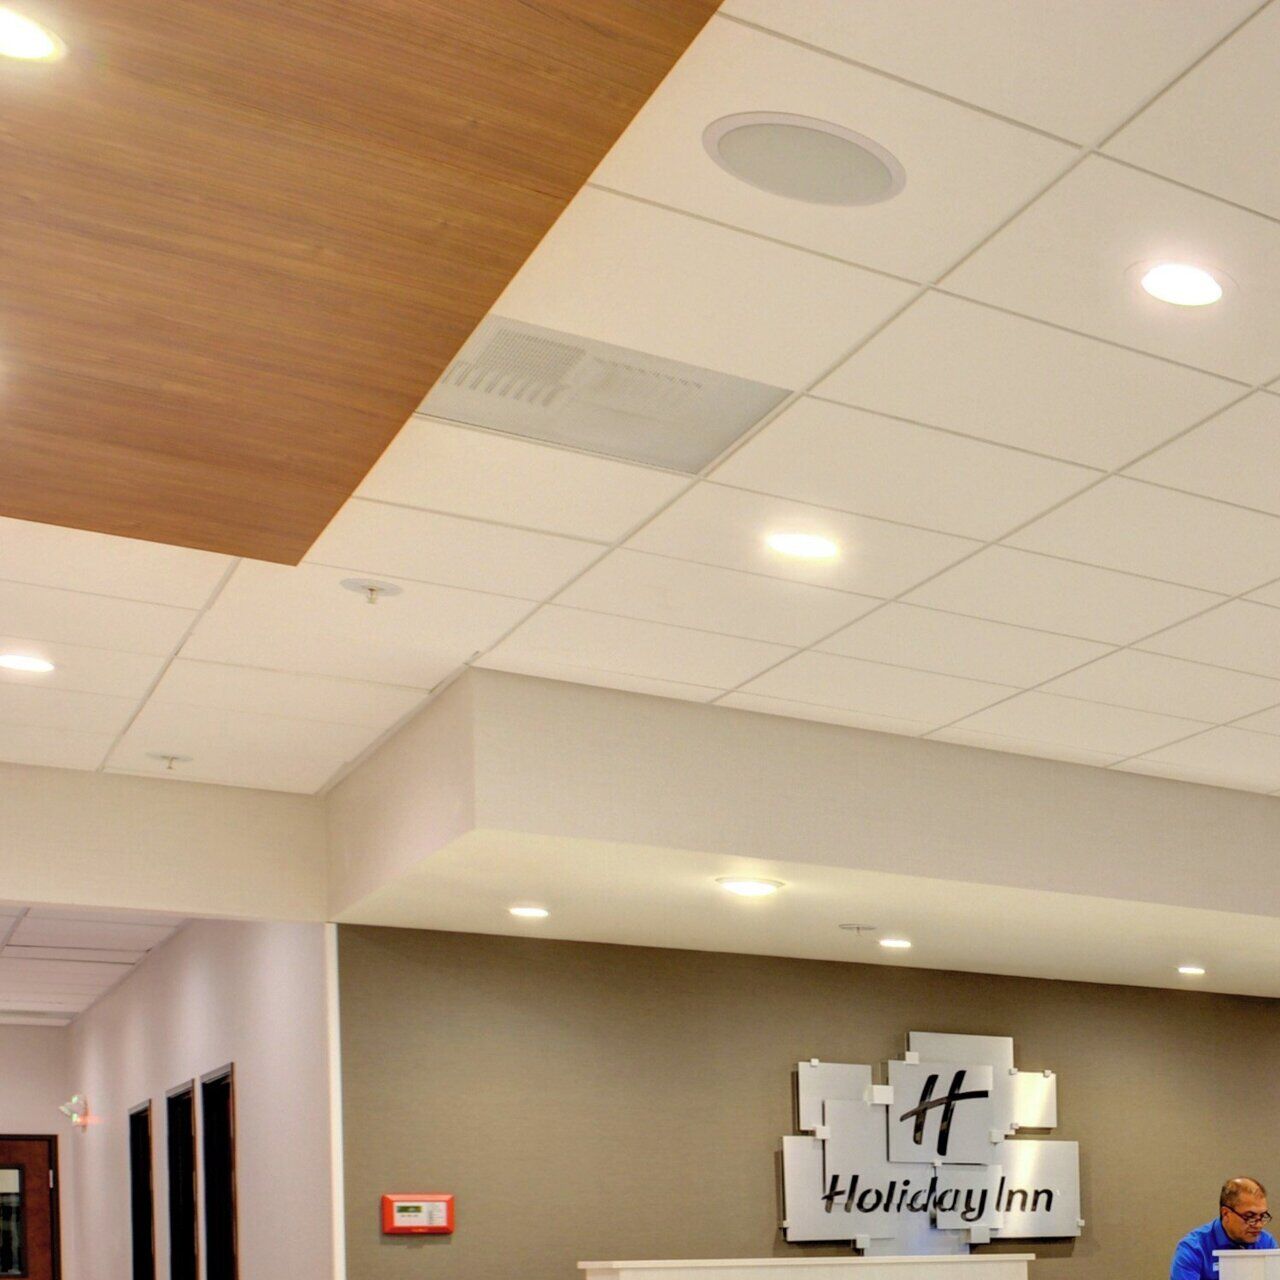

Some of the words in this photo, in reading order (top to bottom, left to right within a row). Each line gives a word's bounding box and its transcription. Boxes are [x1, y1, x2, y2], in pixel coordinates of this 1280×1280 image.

[900, 1070, 989, 1156] H
[822, 1174, 988, 1222] Holiday
[996, 1176, 1053, 1212] Inn
